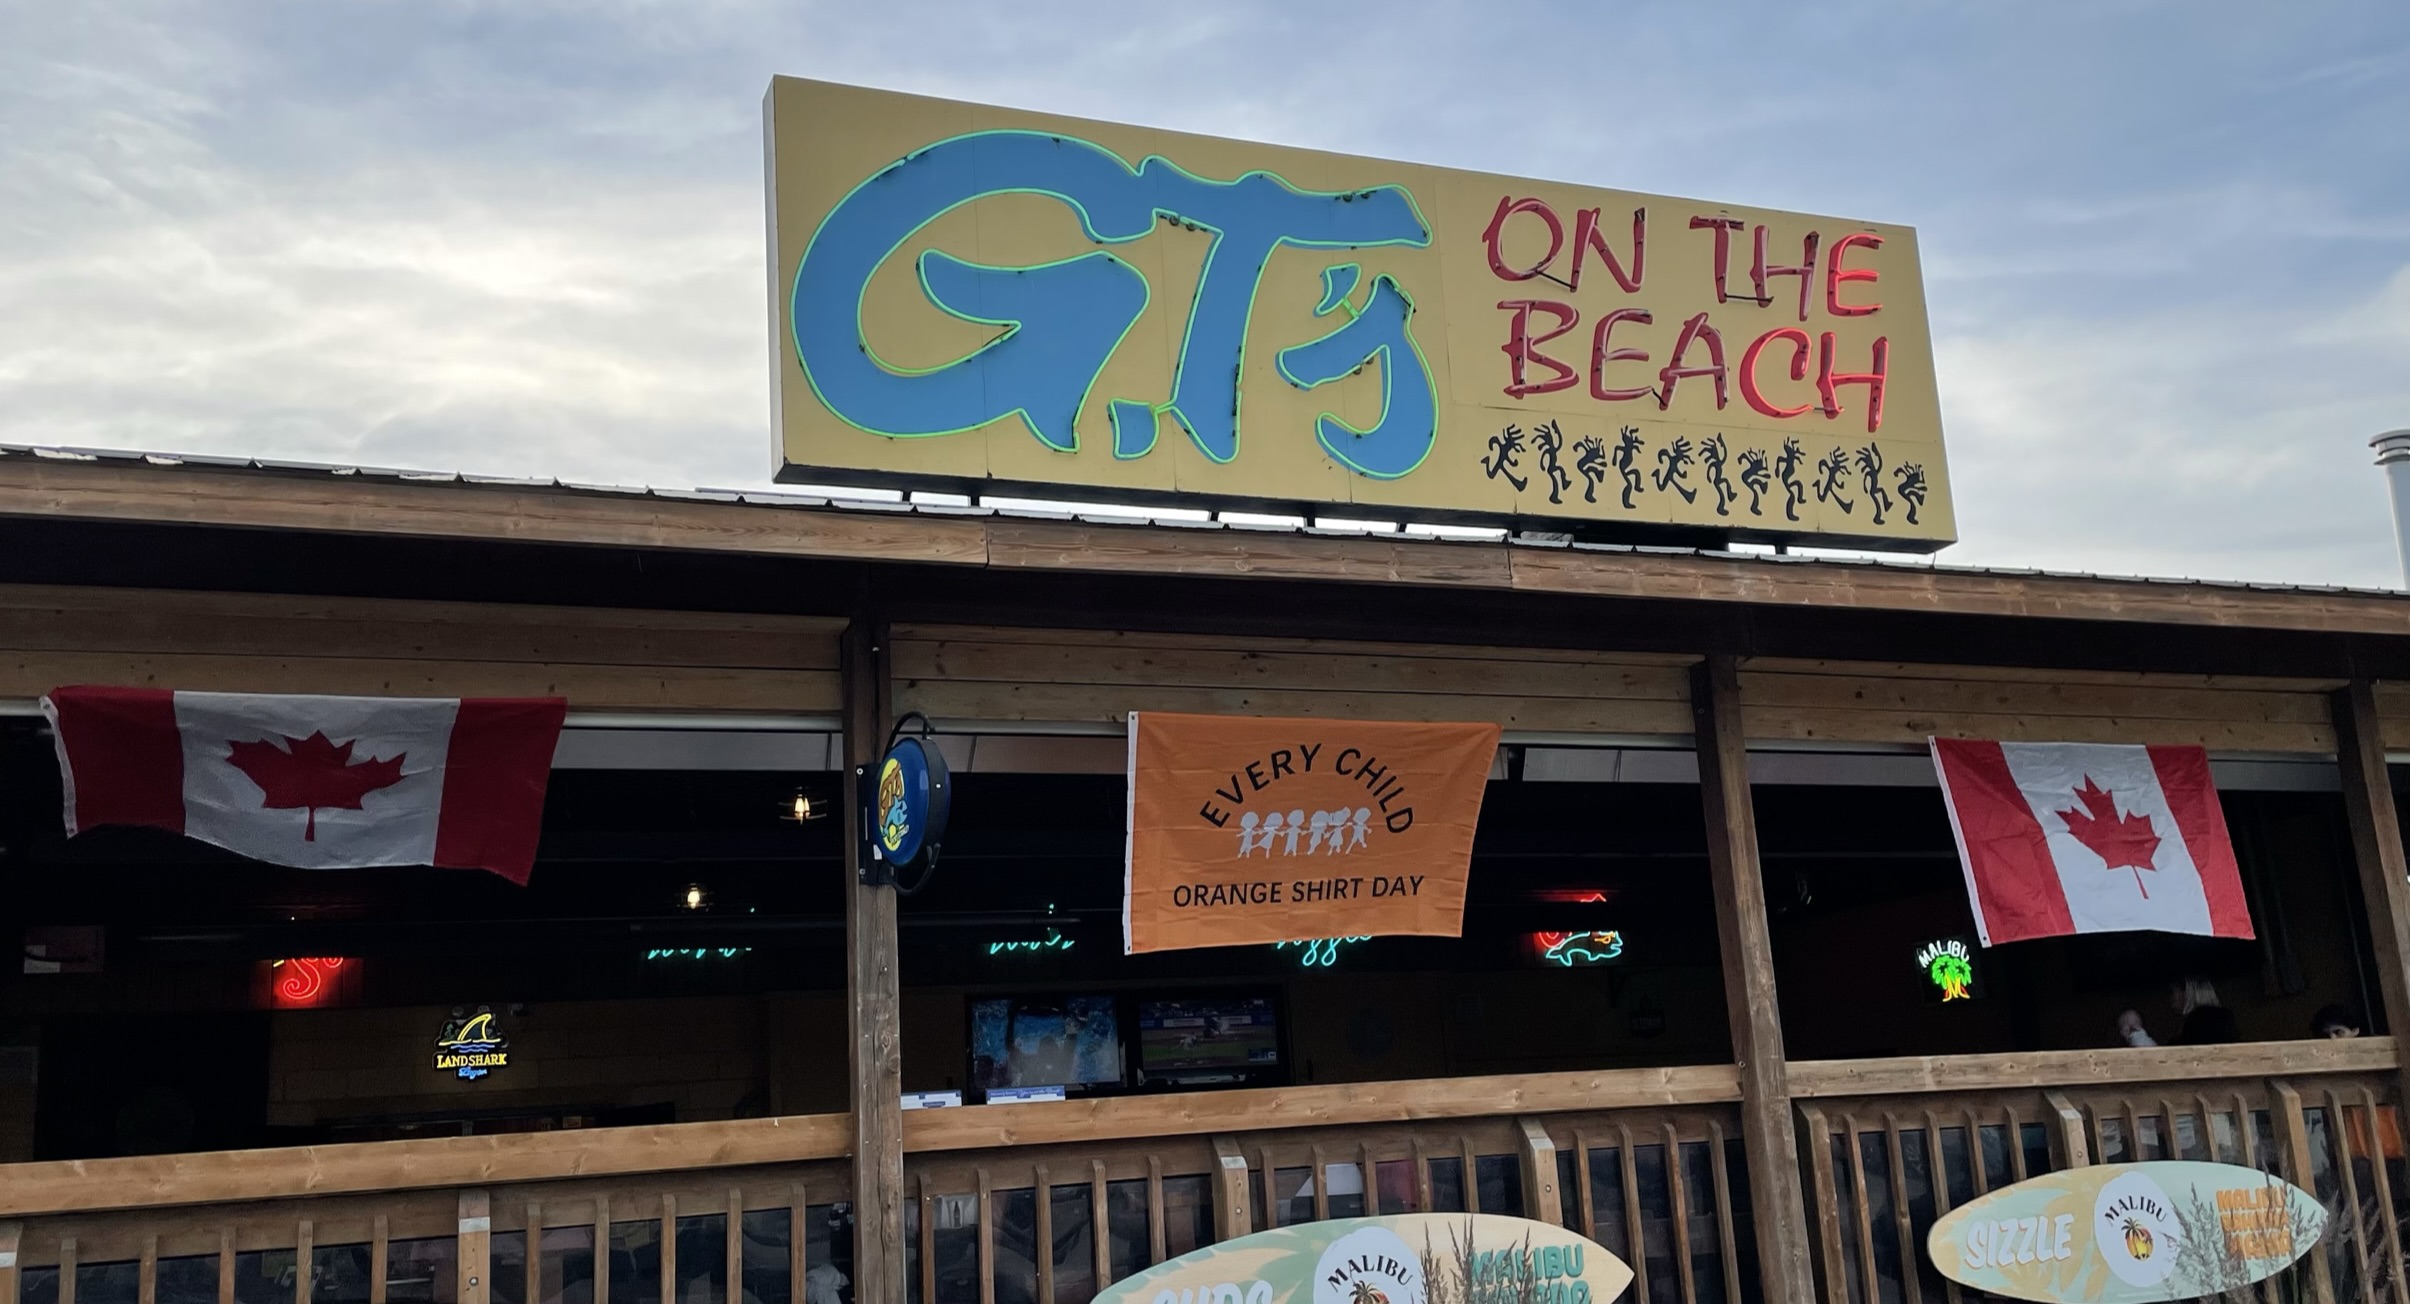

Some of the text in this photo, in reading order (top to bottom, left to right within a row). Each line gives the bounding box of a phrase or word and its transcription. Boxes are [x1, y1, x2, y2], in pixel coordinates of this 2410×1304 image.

[1482, 195, 1885, 321] ON THE
[1497, 300, 1890, 432] BEACH
[1200, 743, 1414, 834] EVERY CHILD
[1173, 875, 1424, 907] ORANGE SHIRT DAY
[1918, 940, 1970, 968] MALIBU
[2105, 1195, 2168, 1227] MALIBU
[1965, 1213, 2074, 1271] SIZZLE
[1328, 1255, 1413, 1291] MALIBU
